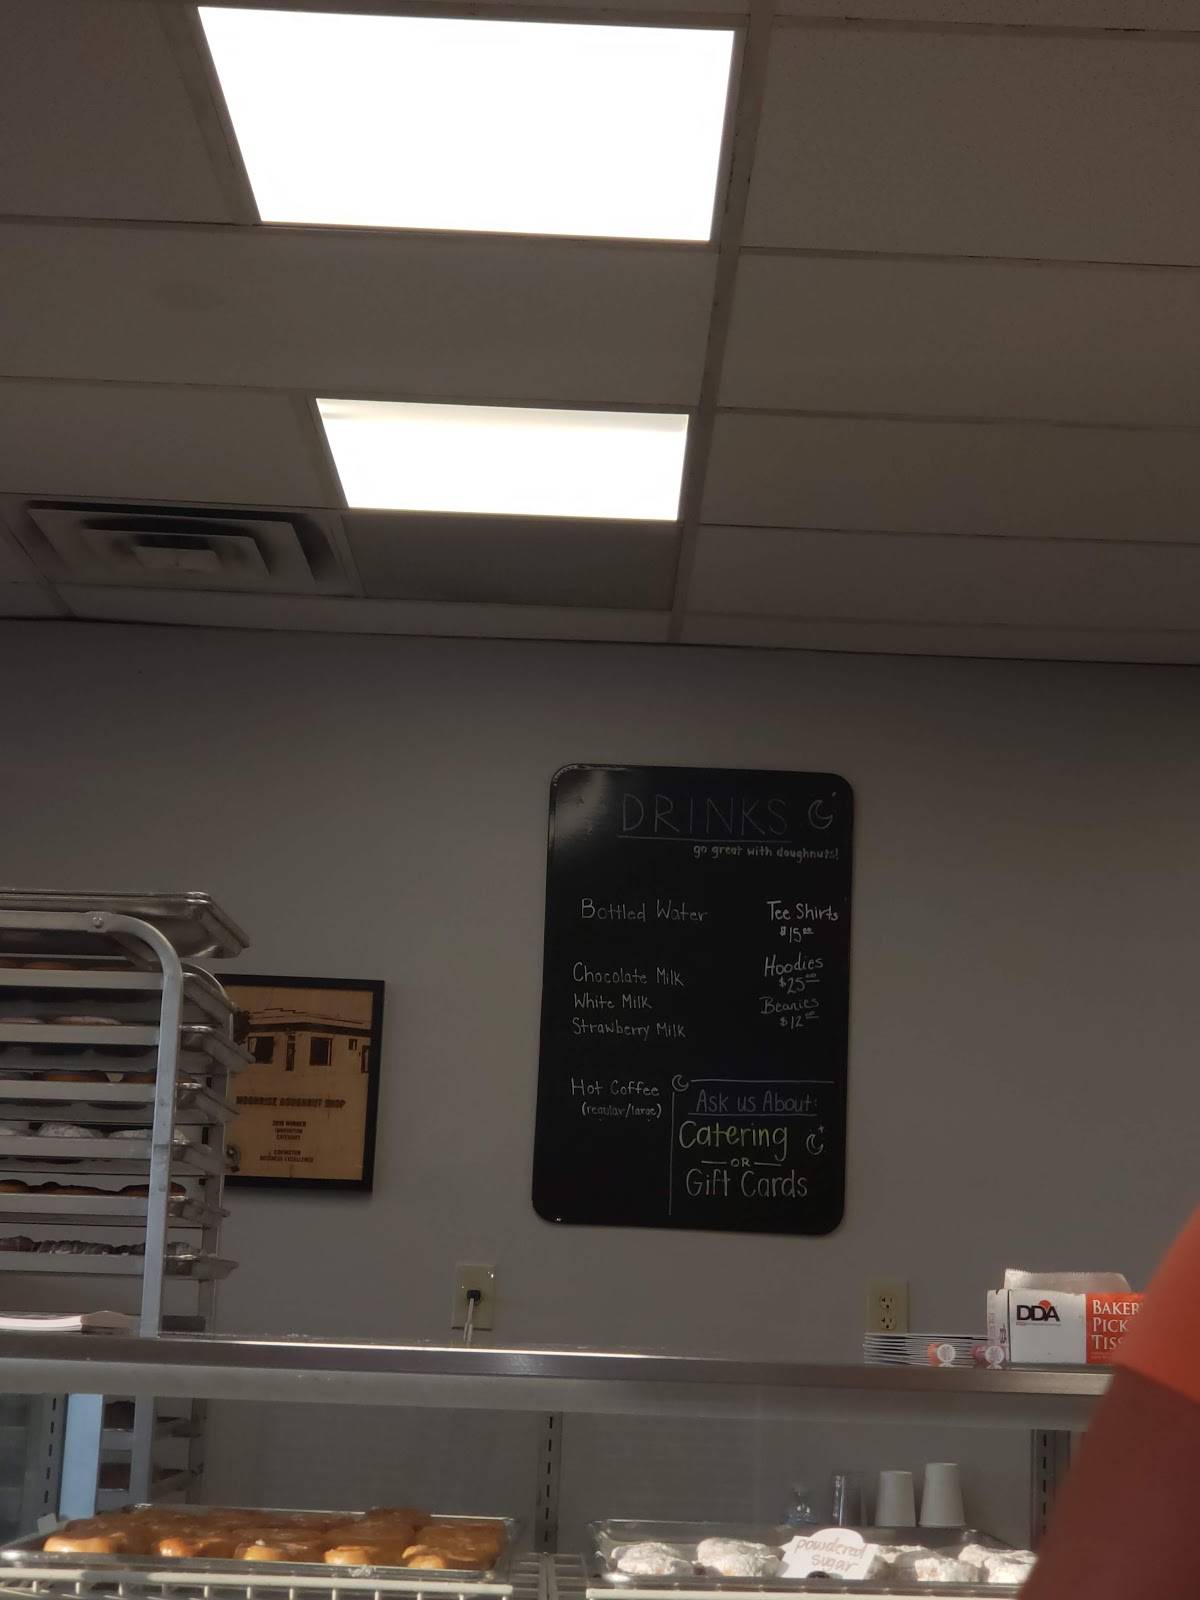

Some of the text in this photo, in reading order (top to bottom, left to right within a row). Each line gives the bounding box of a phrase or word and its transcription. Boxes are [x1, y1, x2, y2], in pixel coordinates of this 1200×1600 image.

[622, 792, 788, 836] DRINKS
[693, 845, 708, 859] go
[711, 845, 743, 859] great
[746, 846, 773, 857] with
[580, 897, 708, 922] Bottled Water
[766, 900, 839, 921] Tee Shirts
[572, 961, 684, 986] Chocolate Milk
[764, 951, 824, 977] Hoodies
[573, 992, 652, 1009] White Milk
[759, 996, 819, 1015] Beanies
[572, 1016, 686, 1041] Strawberry Milk
[571, 1076, 660, 1096] Hot Coffee
[695, 1089, 729, 1112] Ask
[737, 1096, 757, 1112] us
[679, 1120, 788, 1162] Catering
[730, 1157, 751, 1168] OR
[686, 1168, 808, 1198] Gift Cards
[1016, 1304, 1060, 1322] DDA
[1092, 1299, 1143, 1316] BAKER
[793, 1537, 867, 1559] powdered
[810, 1554, 859, 1572] sugar
